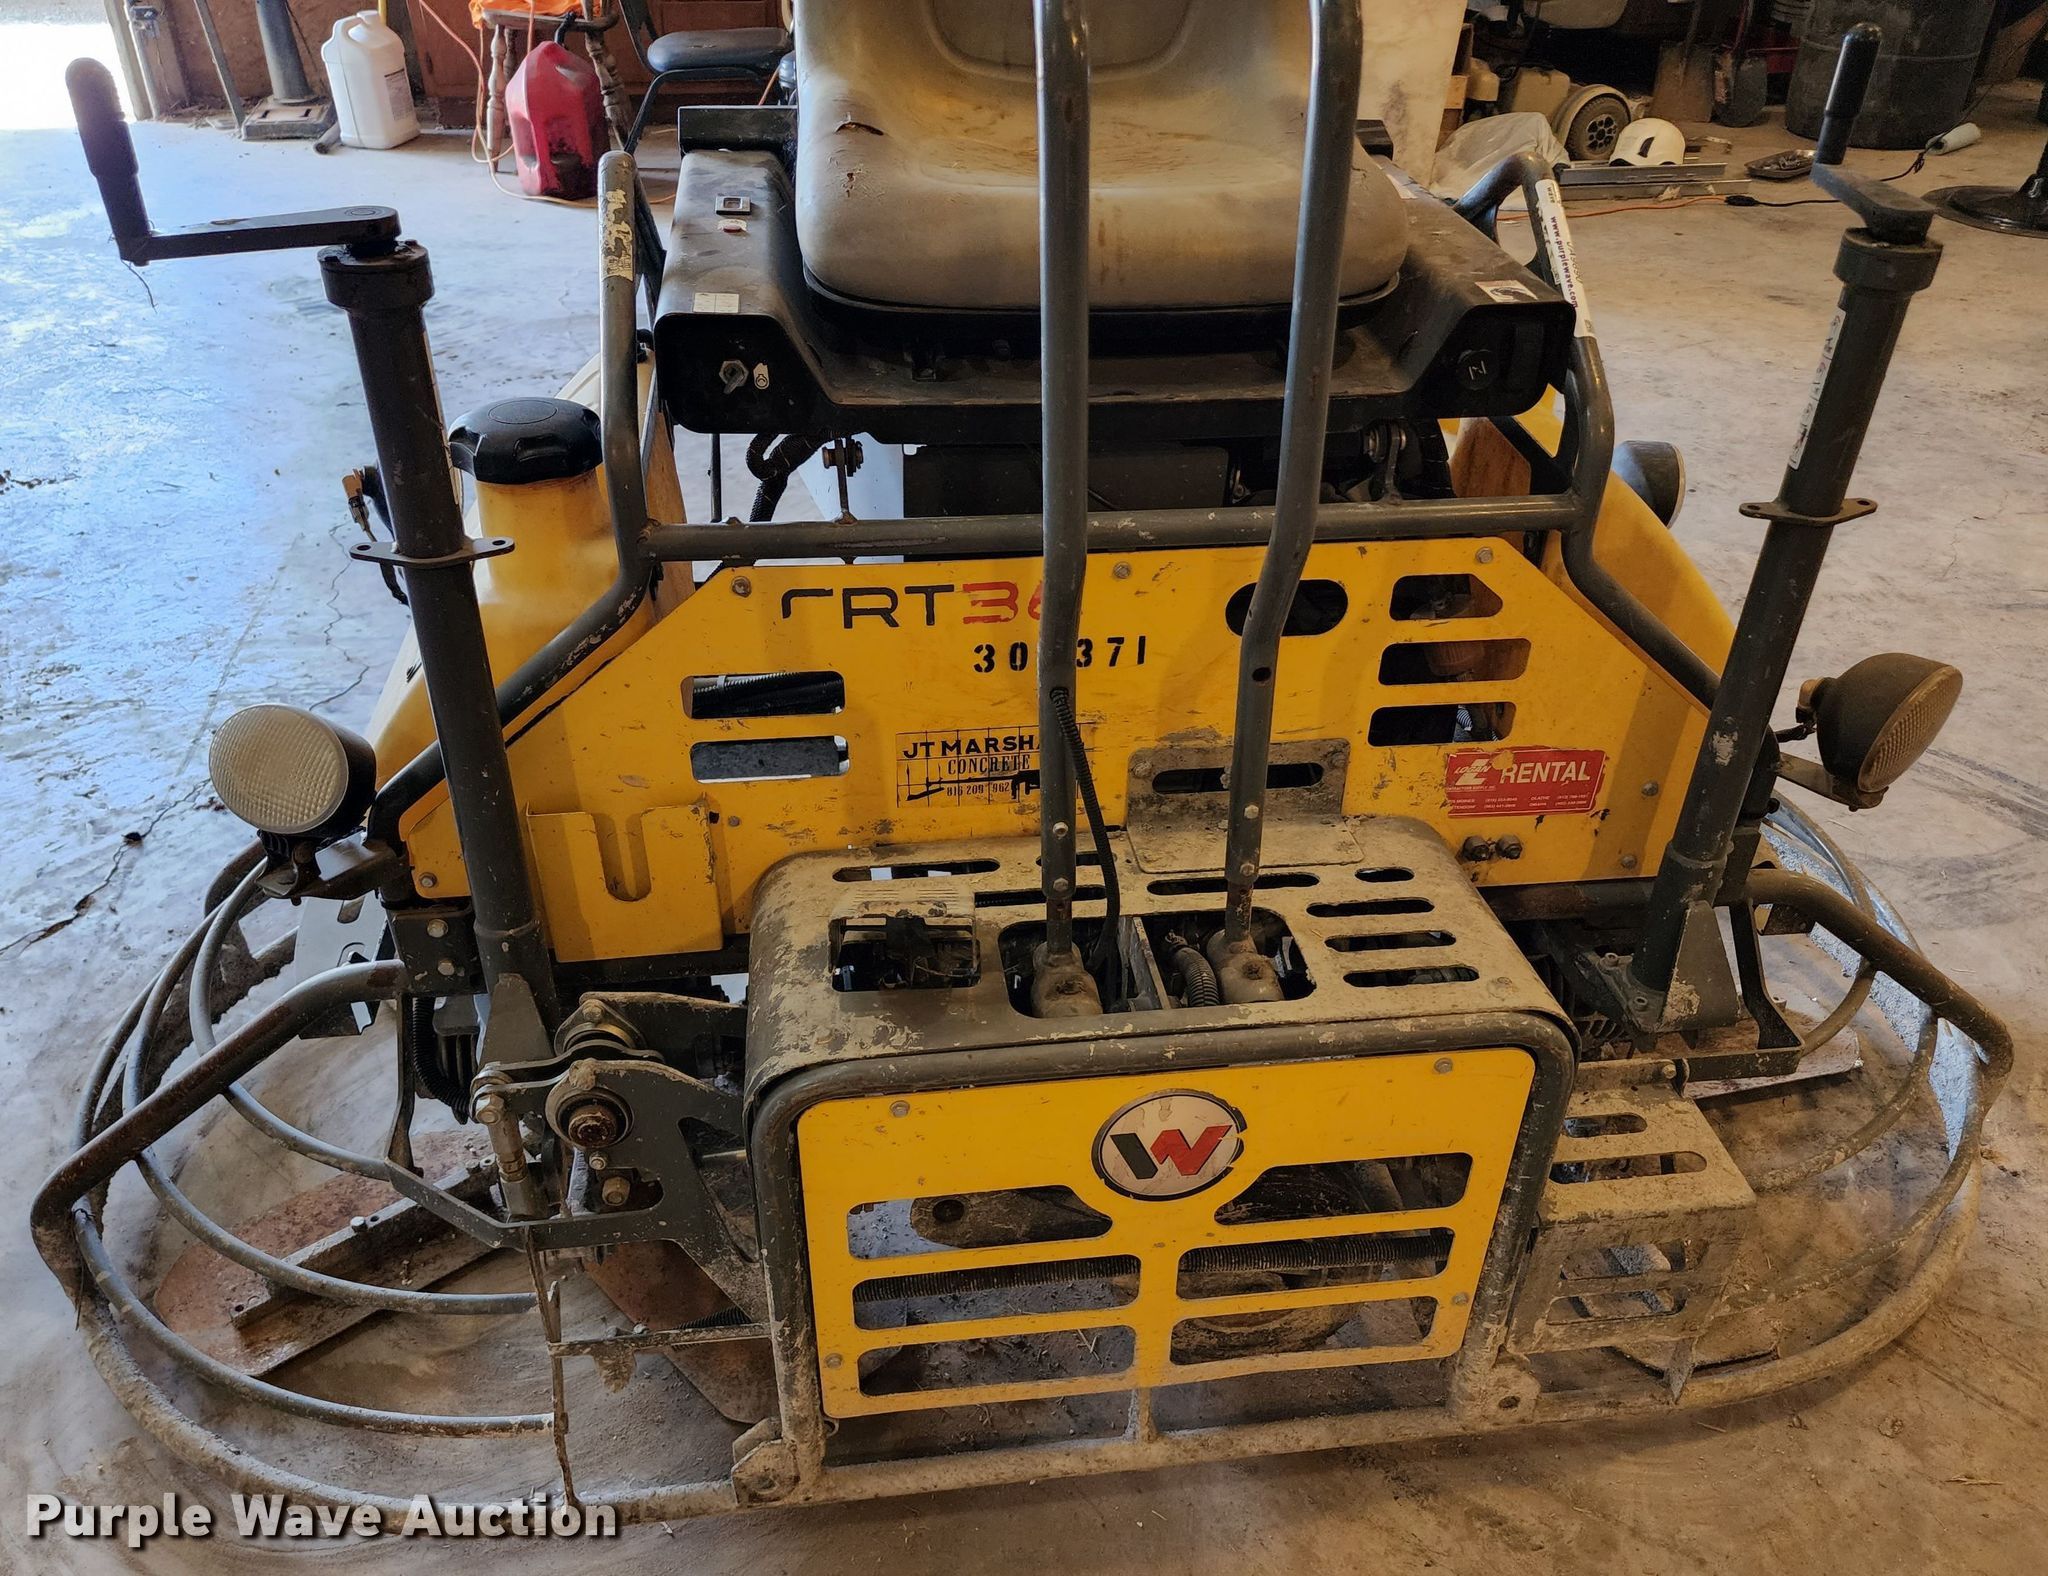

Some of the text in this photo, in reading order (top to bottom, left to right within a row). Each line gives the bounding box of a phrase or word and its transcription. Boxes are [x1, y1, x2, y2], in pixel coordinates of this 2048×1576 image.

[1550, 215, 1579, 308] www.purplewave.com
[973, 635, 1146, 673] 30371
[903, 734, 1041, 759] JT MARSH
[947, 754, 1031, 775] CONCRETE
[1454, 761, 1590, 784] LOGAN RENTAL
[966, 784, 984, 795] 209
